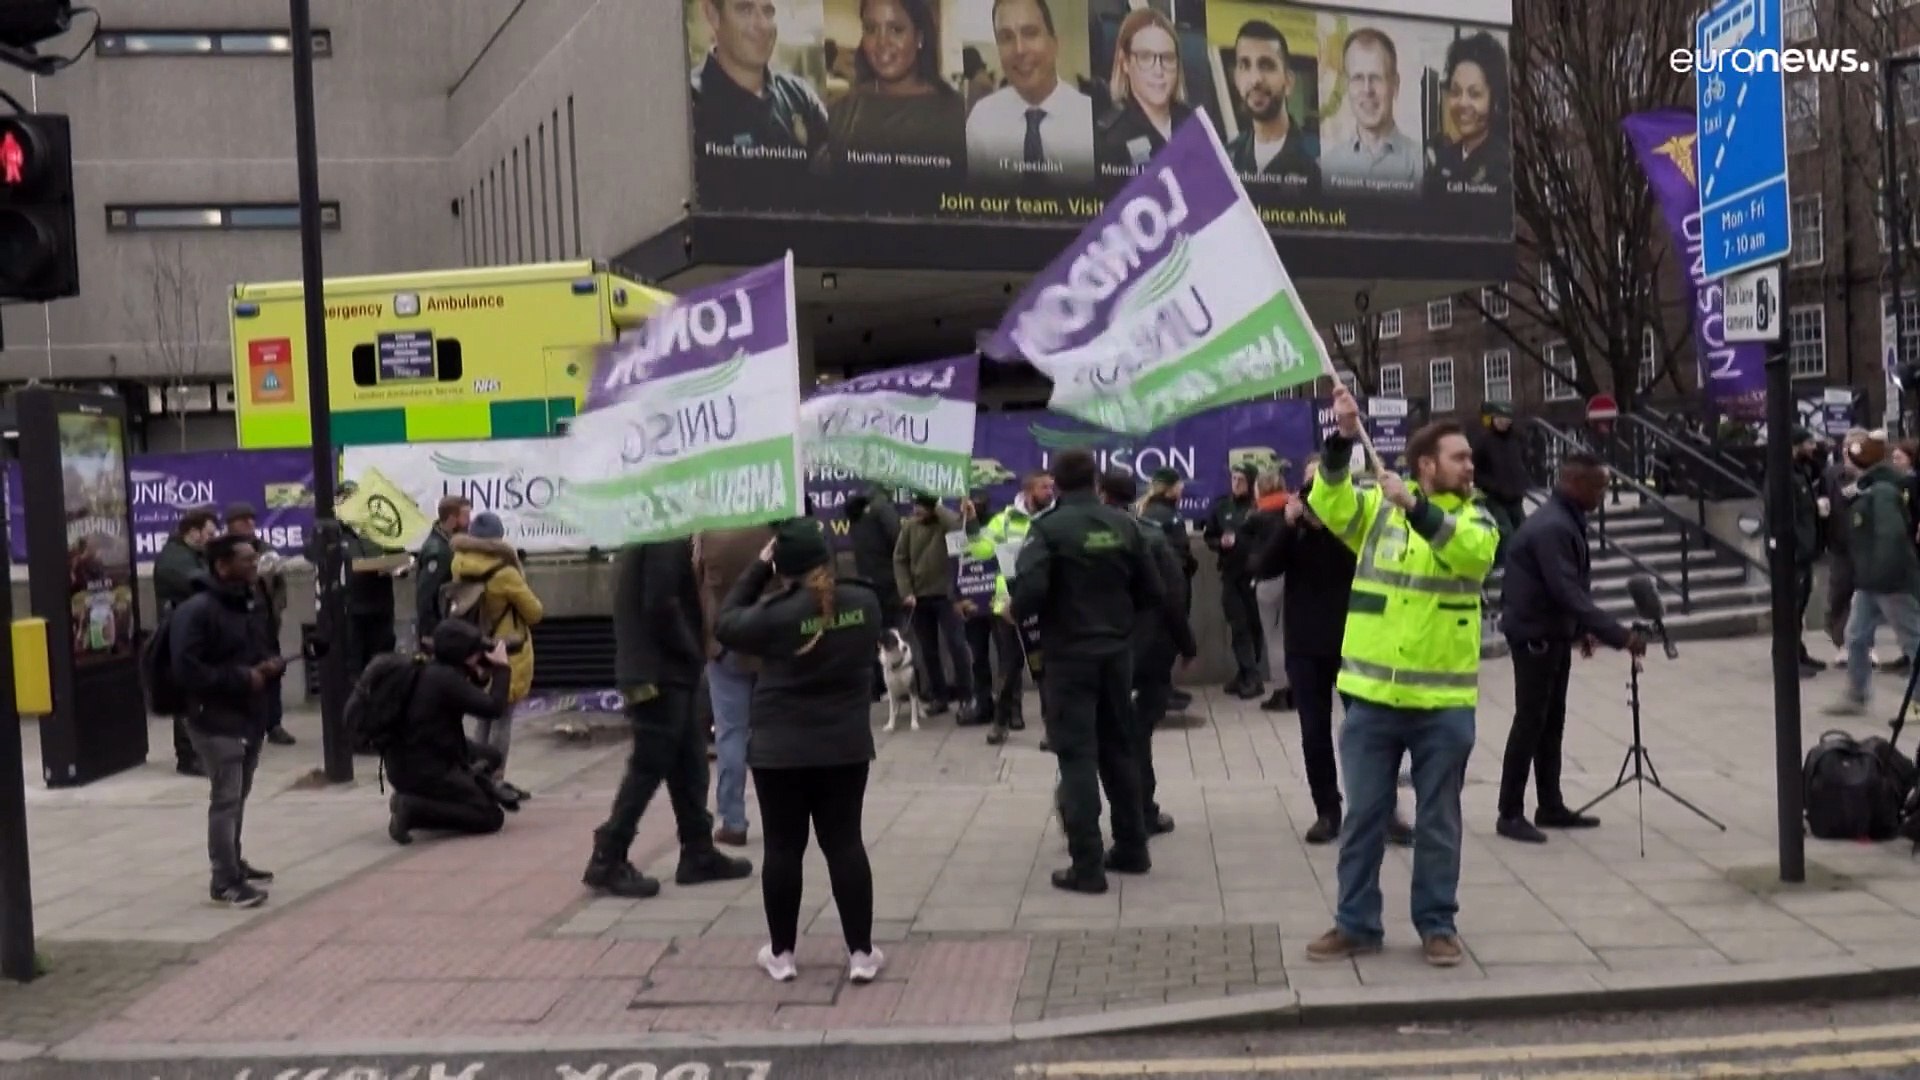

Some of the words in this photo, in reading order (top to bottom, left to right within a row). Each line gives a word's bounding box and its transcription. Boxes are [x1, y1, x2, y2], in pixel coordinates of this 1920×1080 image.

[1704, 110, 1722, 135] taxi
[705, 142, 738, 157] Fleet
[741, 143, 808, 160] technician
[847, 150, 892, 165] Human
[895, 153, 952, 168] resources
[1013, 159, 1064, 174] specialist
[1101, 163, 1140, 177] Mental
[1284, 175, 1308, 186] crew
[1331, 175, 1364, 187] Patient
[1366, 178, 1415, 192] experience
[1447, 182, 1463, 193] Call
[1465, 183, 1498, 194] handler
[939, 192, 975, 211] Join
[980, 199, 1010, 212] our
[1015, 197, 1063, 214] team.
[1068, 198, 1104, 216] Visit
[1257, 205, 1347, 225] lance.nhs.uk
[1722, 211, 1743, 231] Mon
[1751, 196, 1765, 221] Fri
[1738, 285, 1754, 305] lane
[325, 304, 383, 320] ergency
[427, 294, 505, 311] Ambulance
[1726, 315, 1754, 330] cameras
[354, 390, 385, 400] London
[386, 388, 433, 399] Ambulance
[436, 386, 464, 396] Service
[474, 380, 500, 394] NHS
[1042, 446, 1195, 483] ISON
